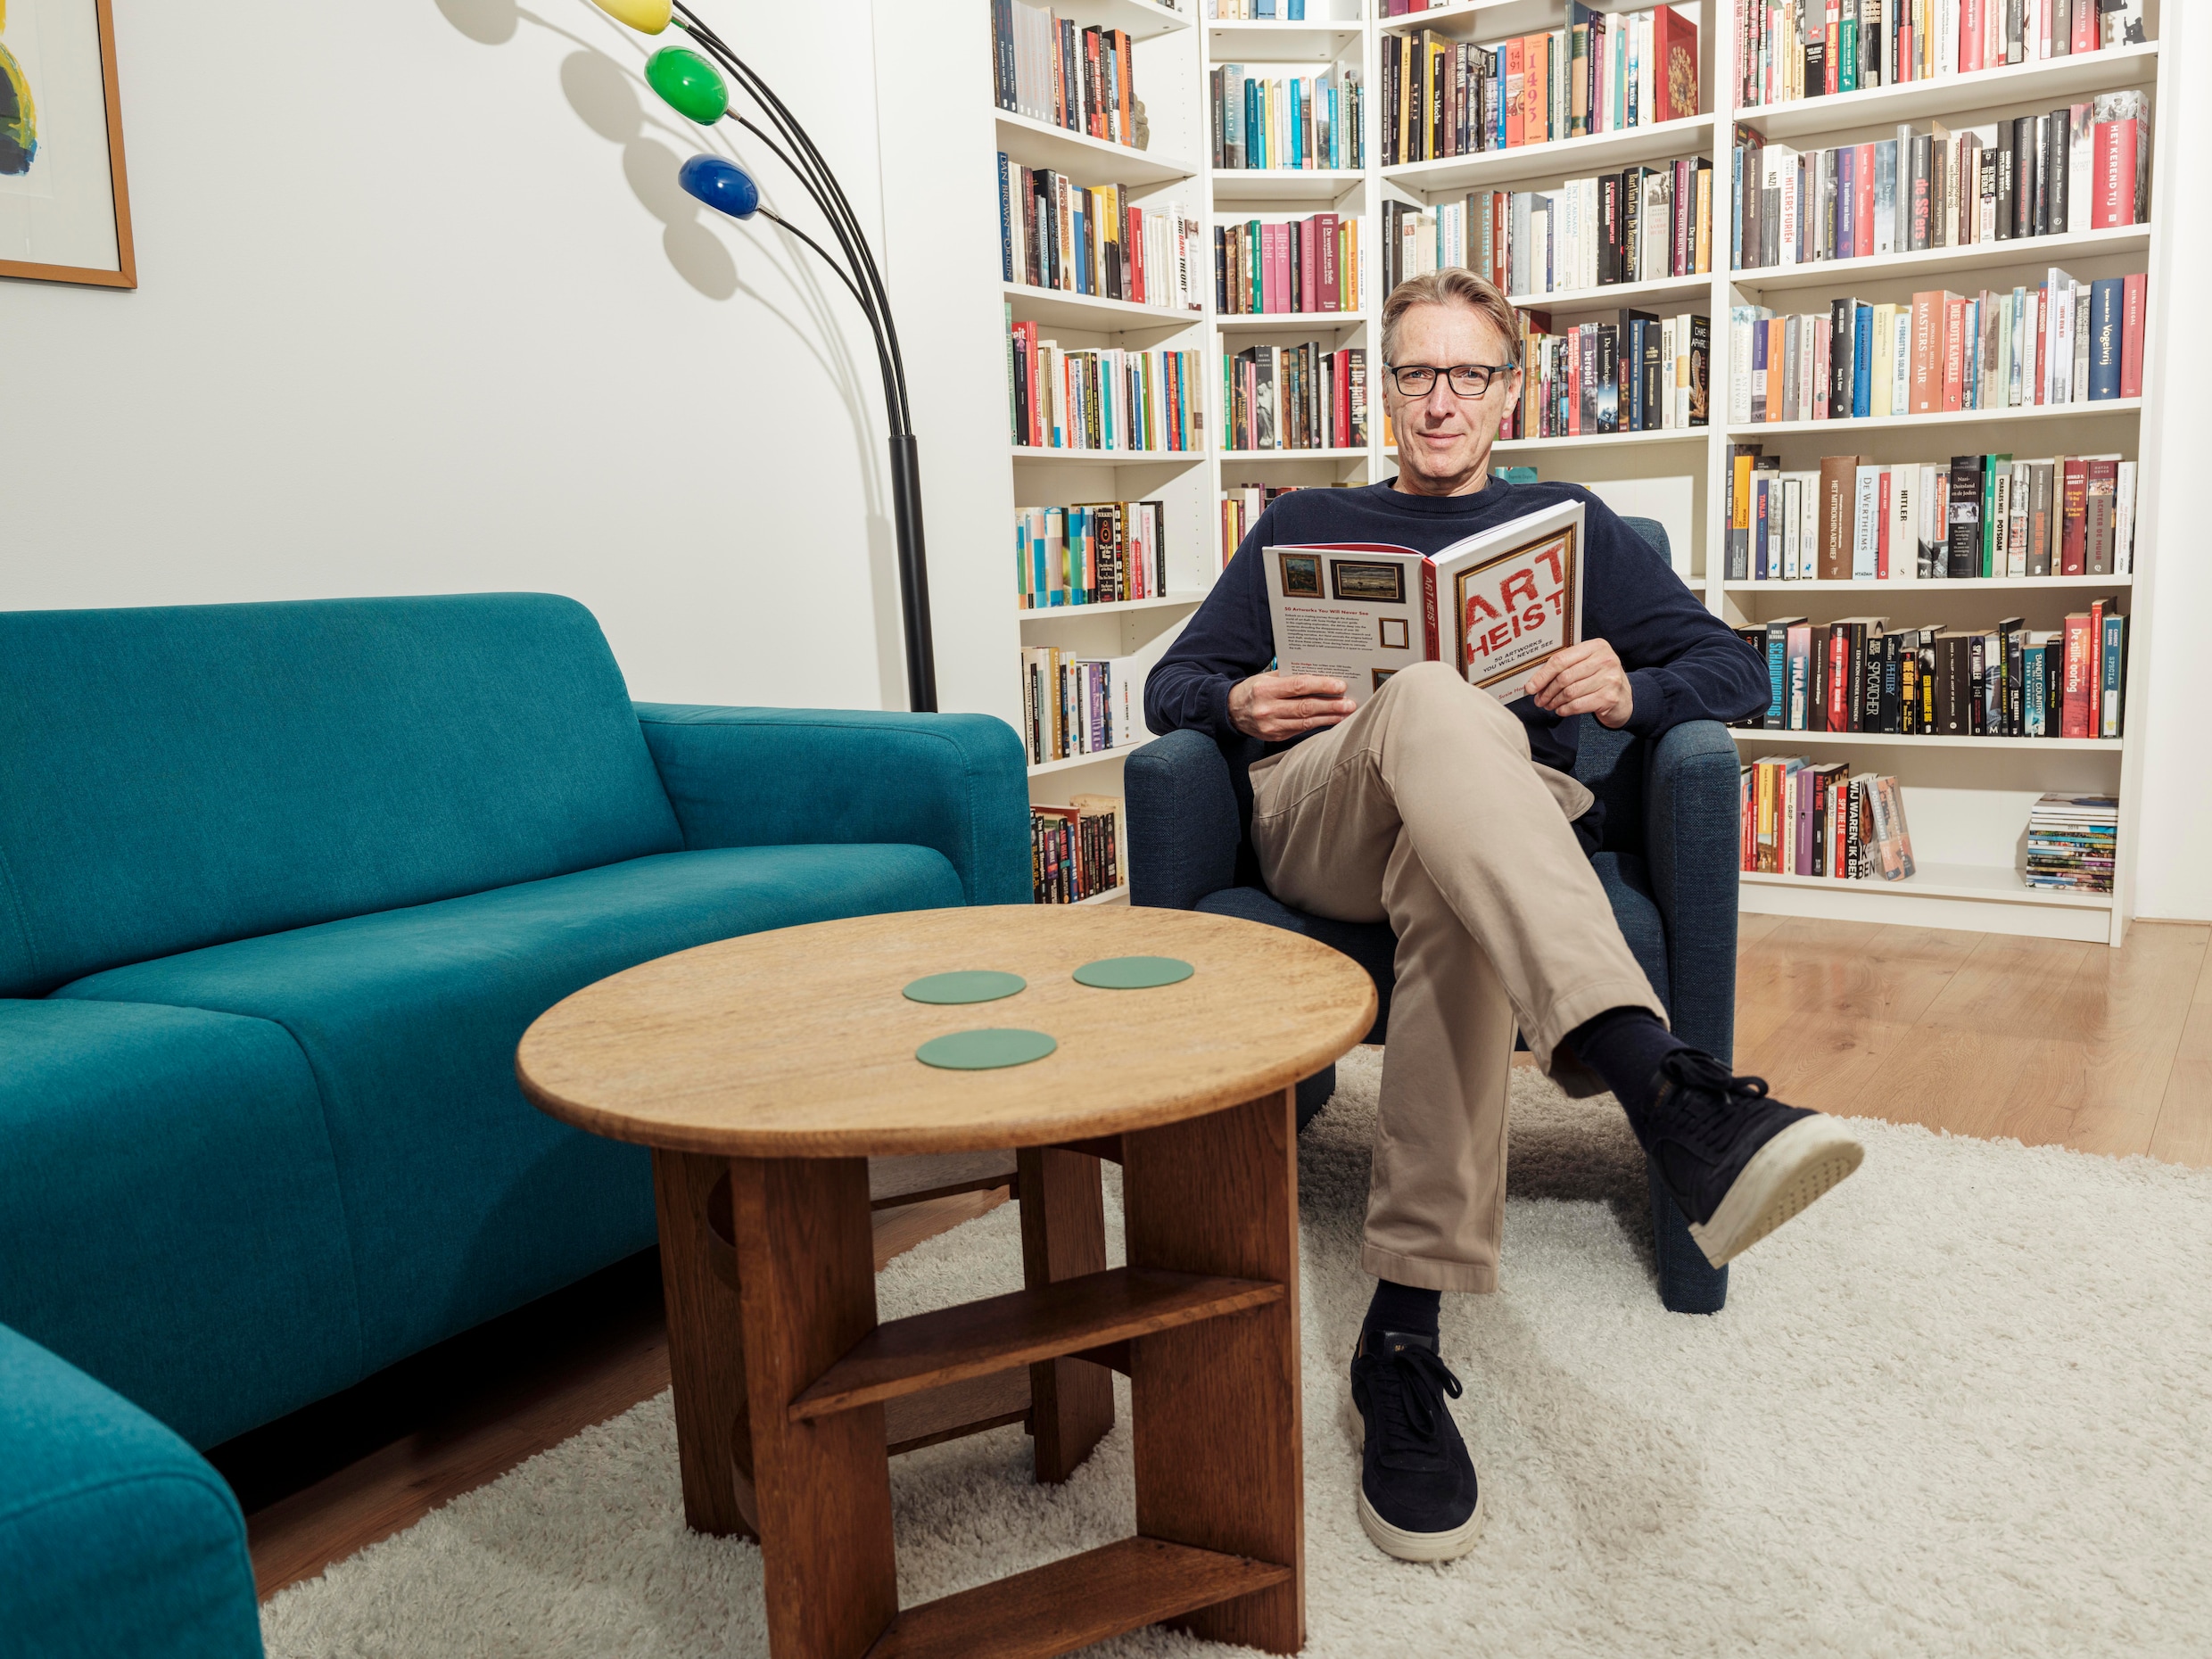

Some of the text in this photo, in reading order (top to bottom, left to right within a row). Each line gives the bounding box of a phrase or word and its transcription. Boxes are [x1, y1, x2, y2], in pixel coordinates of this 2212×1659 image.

[1510, 62, 1520, 70] 91
[1527, 54, 1538, 123] 1493
[1769, 172, 1777, 186] NAZI
[2109, 147, 2118, 188] KEREND
[1482, 194, 1489, 206] DE
[1784, 177, 1795, 243] HITLERS FURIËN
[1915, 179, 1928, 239] de SS'ers
[2108, 191, 2117, 206] TIJ
[1000, 154, 1012, 279] DAN BROWN ORIGIN
[1327, 227, 1332, 236] De
[1626, 174, 1638, 271] Bart Van Loo De Bourgondiërs
[1689, 227, 1695, 236] De
[1179, 258, 1187, 293] THEORY
[1918, 302, 1928, 384] MASTERS AIR
[1949, 304, 1961, 383] DIE ROTE KAPELLE
[2100, 325, 2112, 365] Vogelvrij
[1585, 351, 1593, 385] berooid
[1603, 338, 1611, 390] De kunstbrigade
[2025, 345, 2034, 389] HIROSHIMA
[1349, 371, 1366, 425] De pausen
[1863, 477, 1871, 491] DE
[1861, 493, 1871, 550] WERTHEIMS
[2096, 529, 2103, 537] DE
[1829, 532, 1837, 560] ARCHIEF
[2095, 541, 2103, 560] MUUR
[1425, 574, 1433, 599] ART
[1465, 542, 1564, 636] ART
[1427, 599, 1436, 629] HEIST
[1467, 589, 1564, 665] HEIST
[1483, 640, 1553, 673] YOU WILL NEVER SEE
[1505, 640, 1542, 658] ARTWORKS
[1972, 645, 1982, 680] SPY HANDLER
[2067, 629, 2082, 692] De stille oorlog
[1055, 680, 1060, 689] ON
[1866, 661, 1880, 715] SPYCATCHER
[1886, 664, 1896, 696] PHILBY
[1902, 661, 1914, 700] WE GOT HIM!
[2002, 678, 2007, 686] AN
[1850, 781, 1859, 799] WIJ
[1871, 791, 1886, 839] POLDERJAPANNER
[1848, 846, 1856, 856] IK
[1848, 859, 1856, 879] BEN
